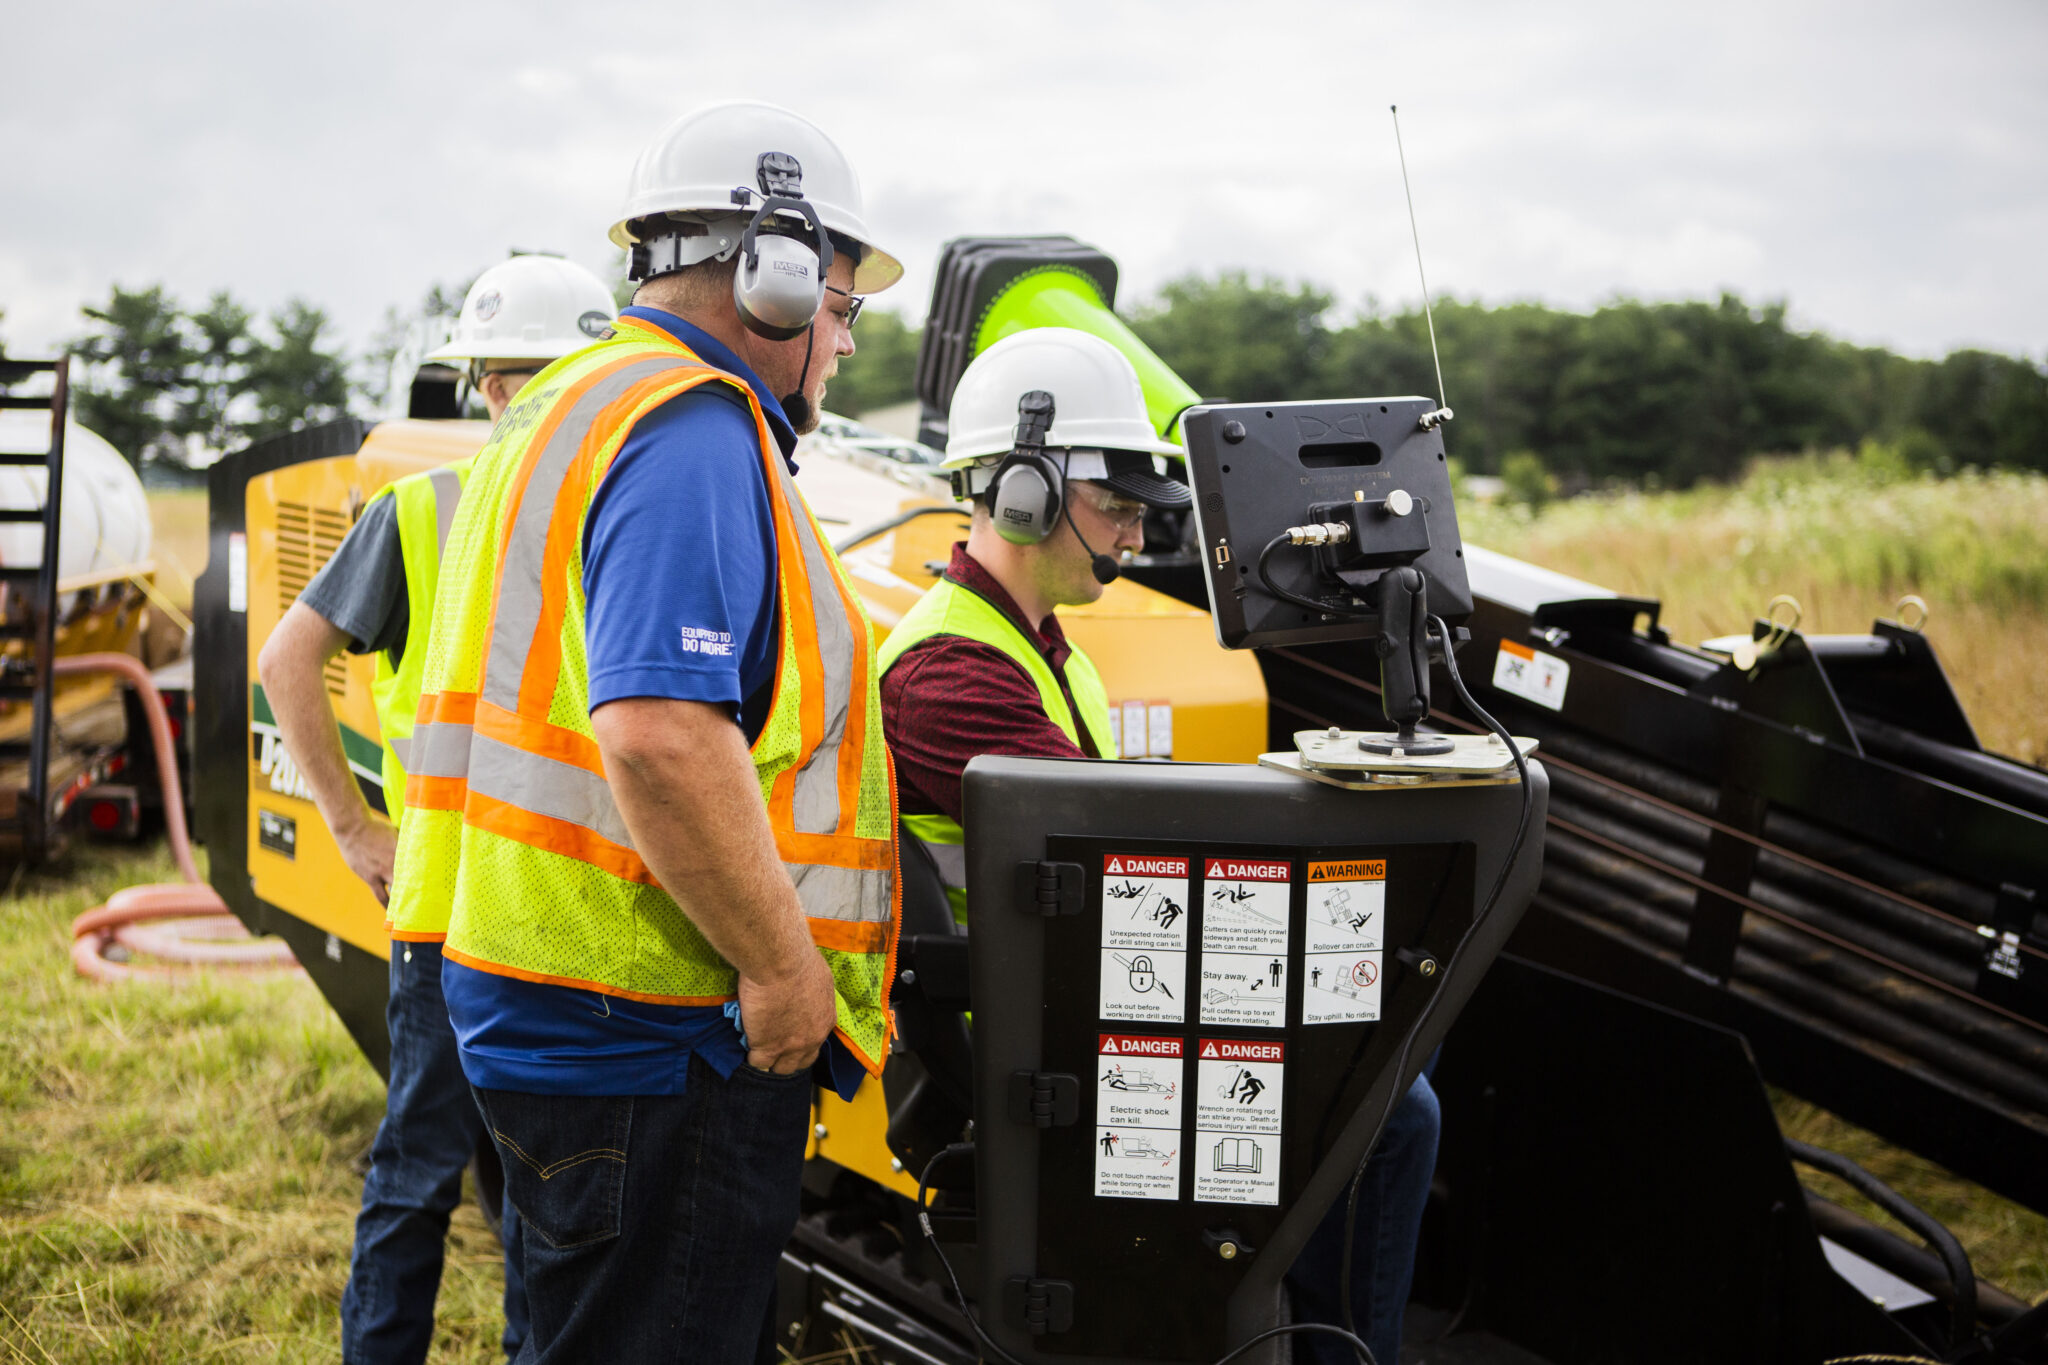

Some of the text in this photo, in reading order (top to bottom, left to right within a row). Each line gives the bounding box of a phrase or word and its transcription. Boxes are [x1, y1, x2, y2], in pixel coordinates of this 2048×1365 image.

[775, 262, 806, 275] MSA
[1005, 509, 1030, 522] MSA
[682, 627, 731, 642] EQUIPPED TO
[682, 638, 698, 652] DO
[1126, 860, 1186, 875] DANGER
[1228, 864, 1287, 878] DANGER
[1326, 864, 1383, 878] WARNING
[1203, 971, 1248, 982] Stay away.
[1121, 1040, 1180, 1054] DANGER
[1222, 1044, 1281, 1058] DANGER
[1111, 1106, 1141, 1114] Electric
